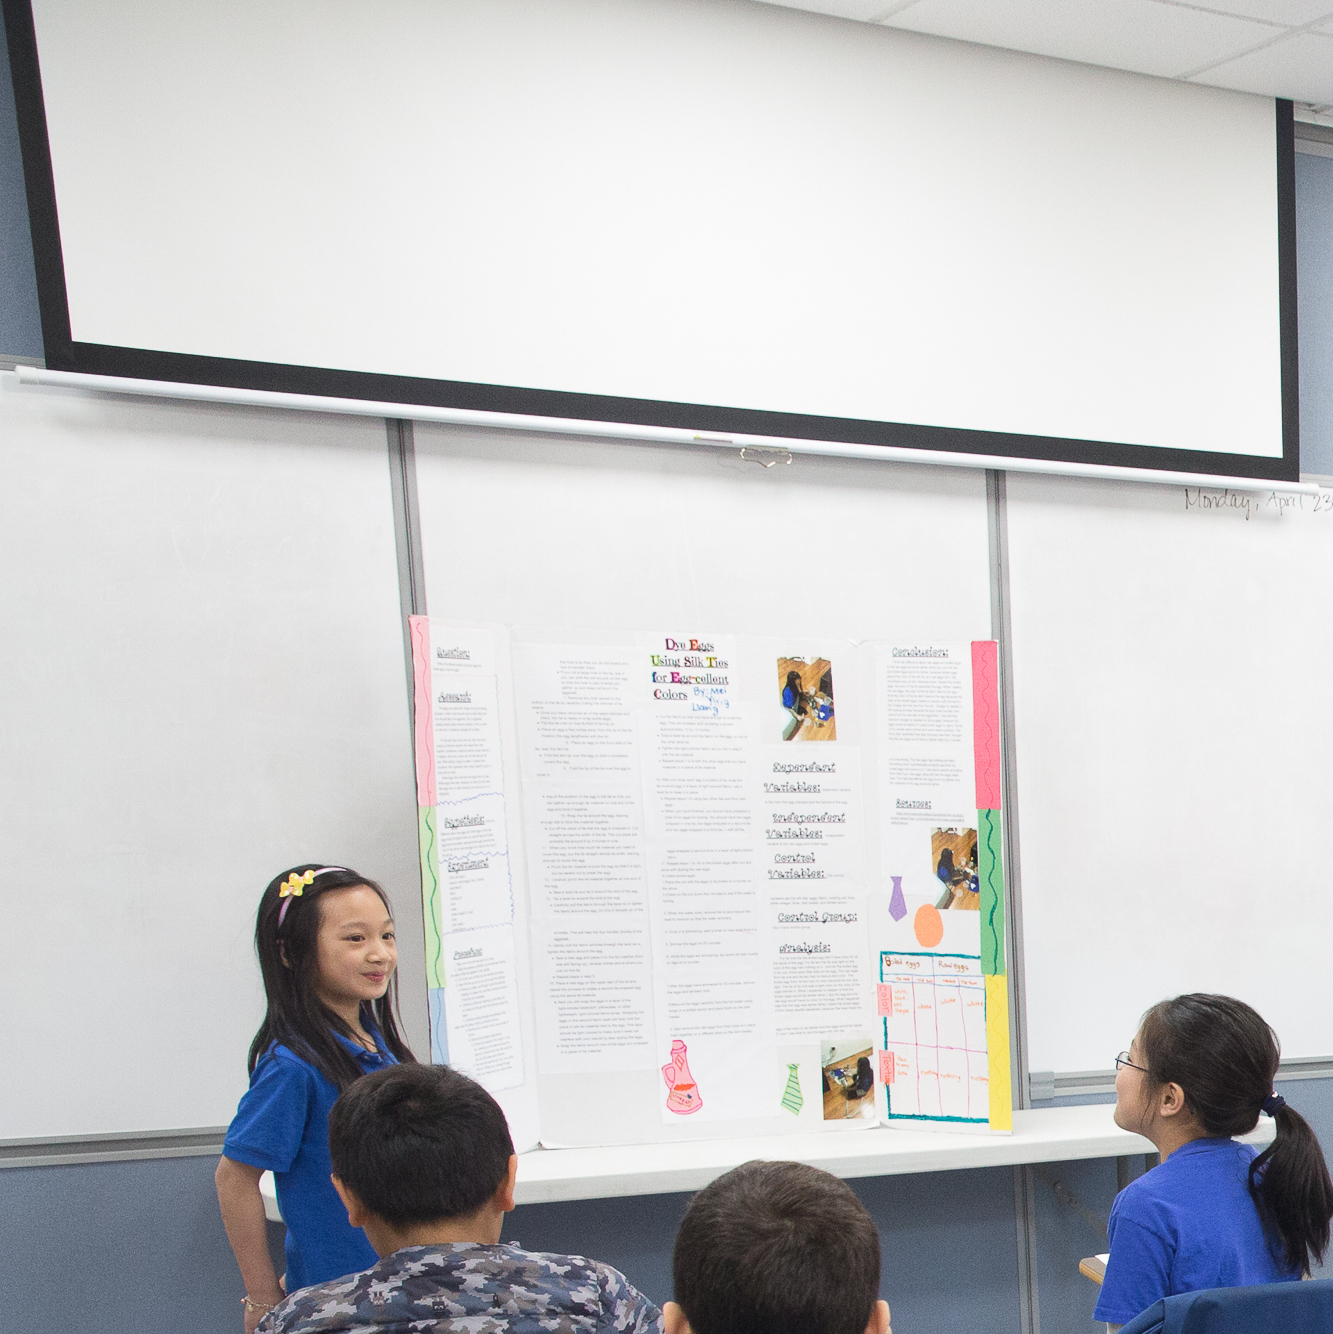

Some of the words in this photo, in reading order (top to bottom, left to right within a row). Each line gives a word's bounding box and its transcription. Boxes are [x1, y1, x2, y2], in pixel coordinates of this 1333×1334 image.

[1184, 488, 1259, 521] Monday,
[1266, 492, 1303, 516] April
[665, 638, 686, 652] Dye
[689, 639, 715, 653] Eggs
[650, 655, 681, 669] Using
[684, 656, 704, 668] Silk
[706, 656, 729, 669] Ties
[652, 672, 667, 684] for
[670, 672, 730, 686] Egg-cellent
[653, 689, 688, 701] Colors
[773, 812, 847, 825] Independent
[774, 852, 816, 863] Control
[778, 911, 819, 923] Control
[821, 912, 858, 924] Group:
